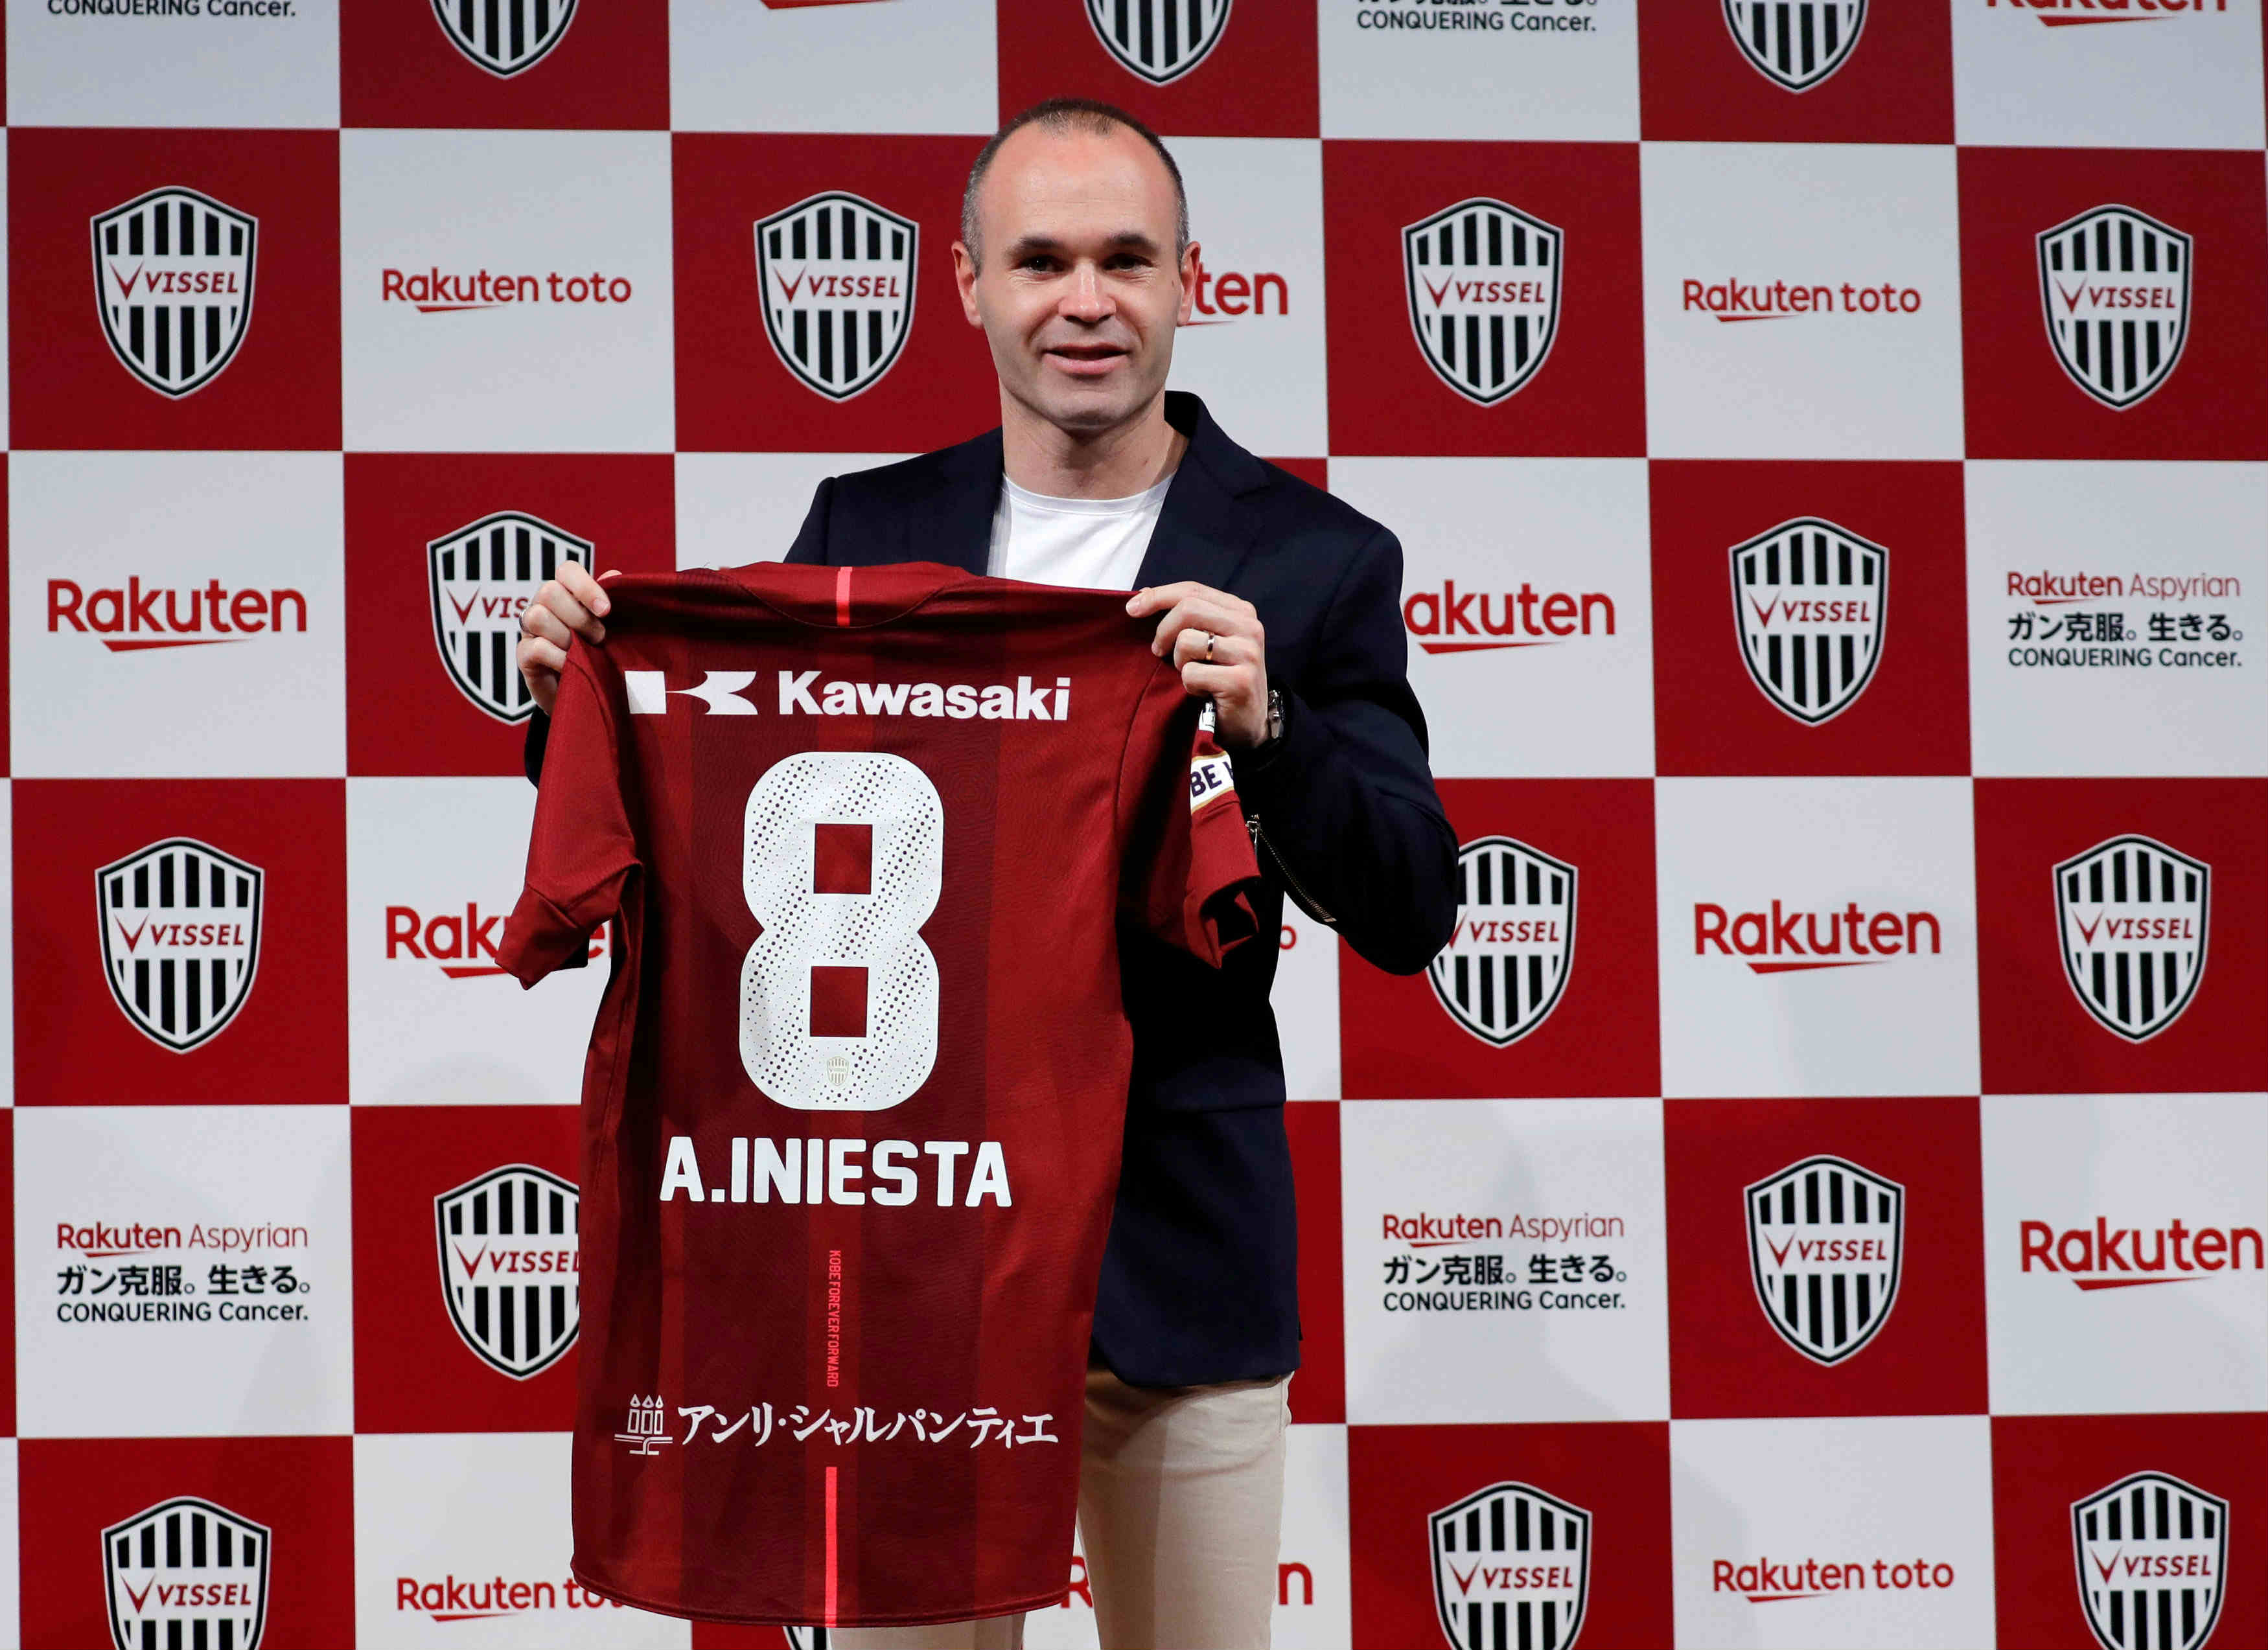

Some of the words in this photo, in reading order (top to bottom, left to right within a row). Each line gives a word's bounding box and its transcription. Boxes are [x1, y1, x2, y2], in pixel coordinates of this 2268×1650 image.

[48, 0, 200, 15] CONQUERING
[208, 0, 295, 16] Cancer.
[1358, 11, 1503, 30] CONQUERING
[1512, 12, 1595, 30] Cancer.
[146, 272, 237, 293] VISSEL
[383, 267, 538, 302] Rakuten
[547, 272, 631, 303] toto
[808, 276, 898, 297] VISSEL
[1455, 282, 1544, 303] VISSEL
[1684, 278, 1833, 312] Rakuten
[1840, 283, 1921, 313] toto
[2089, 288, 2174, 308] VISSEL
[2008, 573, 2122, 596] Rakuten
[2131, 575, 2239, 596] Aspyrian
[48, 576, 307, 633] Rakuten
[482, 597, 529, 618] VIS
[1404, 579, 1615, 636] akuten
[1782, 601, 1869, 622] VISSEL
[2009, 648, 2151, 666] CONQUERING
[2159, 649, 2240, 666] Cancer.
[779, 671, 1070, 720] Kawasaki
[150, 924, 244, 946] VISSEL
[739, 752, 943, 1110] 8
[1470, 921, 1558, 942] VISSEL
[1695, 900, 1941, 956] Rakuten
[2106, 917, 2192, 939] VISSEL
[660, 1137, 1012, 1207] A.INIESTA
[58, 1223, 181, 1249] Rakuten
[188, 1225, 308, 1252] Aspyrian
[1383, 1214, 1502, 1239] Rakuten
[1509, 1213, 1625, 1243] Aspyrian
[1798, 1240, 1886, 1261] VISSEL
[2020, 1217, 2263, 1272] Rakuten
[829, 1250, 841, 1280] KOBE
[58, 1303, 211, 1322] CONQUERING
[220, 1302, 307, 1320] Cancer.
[828, 1281, 841, 1333] FOREVER
[1384, 1291, 1531, 1311] CONQUERING
[1540, 1291, 1624, 1309] Cancer.
[827, 1334, 840, 1387] FORWARD
[1483, 1567, 1573, 1588] VISSEL
[1714, 1557, 1865, 1592] Rakuten
[1873, 1560, 1954, 1589] toto
[2124, 1555, 2210, 1577] VISSEL
[157, 1584, 251, 1607] VISSEL
[397, 1576, 555, 1610] Rakuten
[563, 1576, 623, 1609] to
